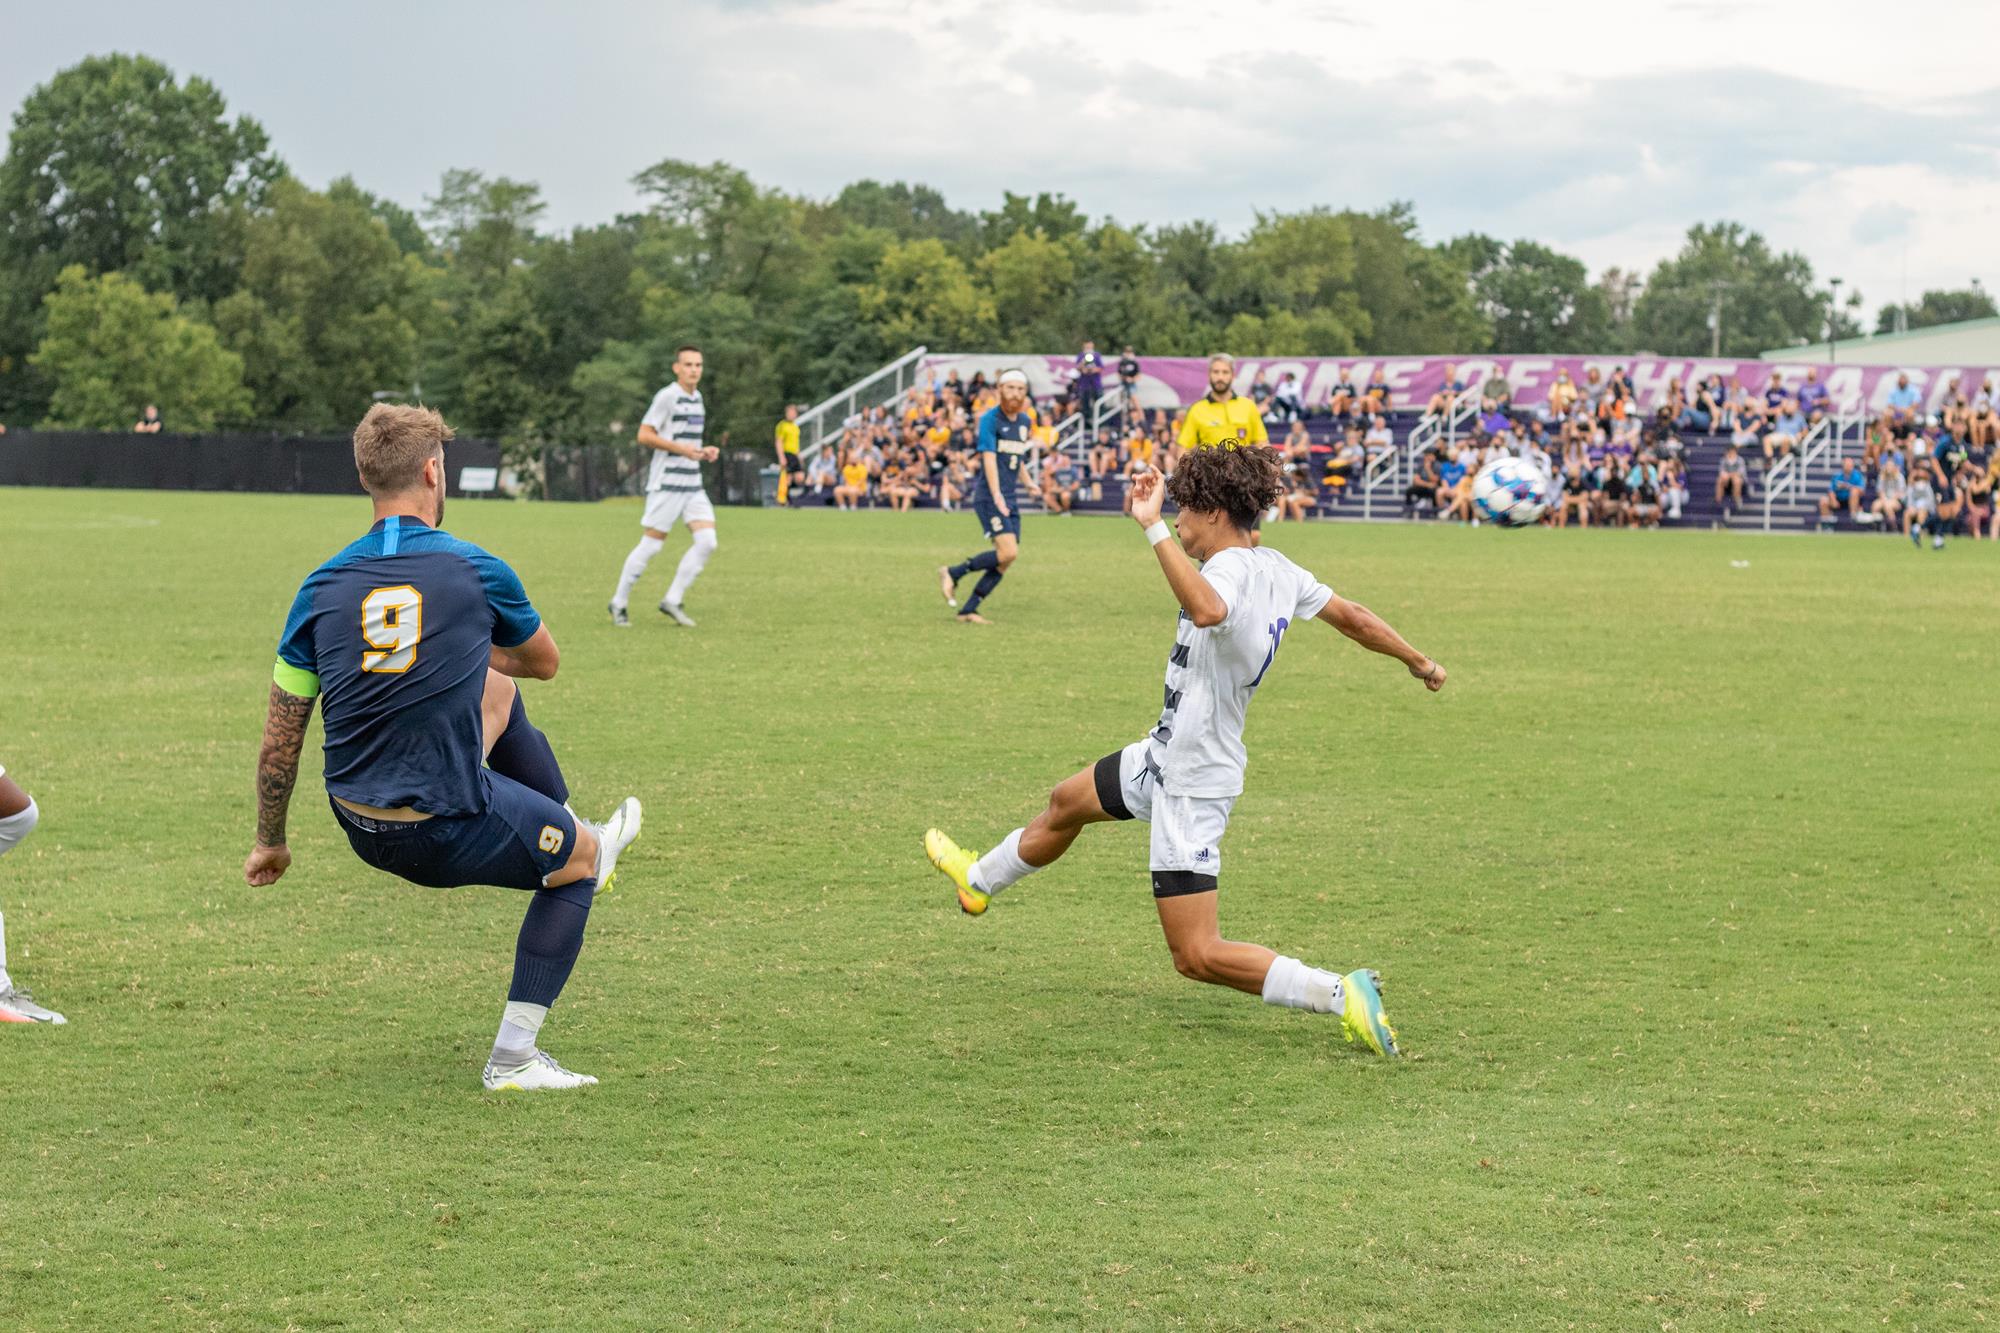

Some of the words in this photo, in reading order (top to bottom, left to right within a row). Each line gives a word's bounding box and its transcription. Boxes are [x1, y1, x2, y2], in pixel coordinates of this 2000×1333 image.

[991, 516, 1003, 532] 2
[361, 584, 423, 673] 9
[538, 825, 565, 855] 9
